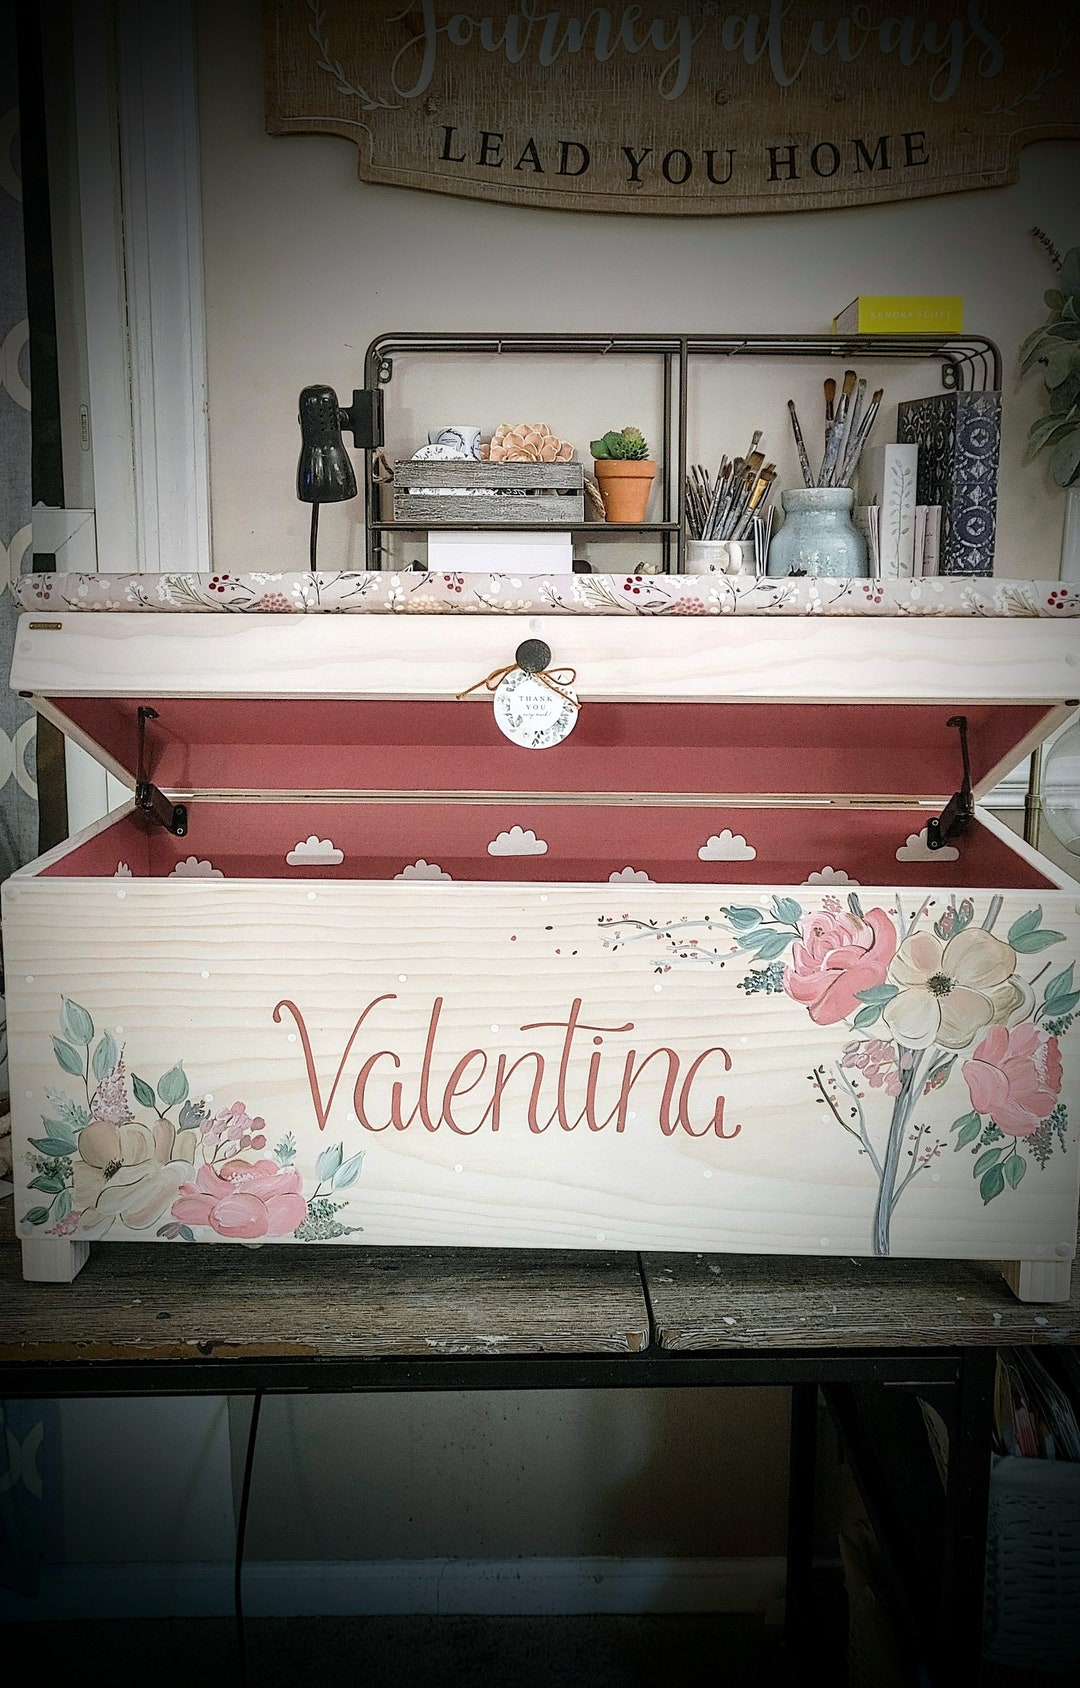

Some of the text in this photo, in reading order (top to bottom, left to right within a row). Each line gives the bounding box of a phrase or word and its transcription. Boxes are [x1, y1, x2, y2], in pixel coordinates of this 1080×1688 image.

[438, 126, 931, 186] LEAD YOU HOME
[870, 310, 952, 319] KENDRA SCOTT
[272, 993, 742, 1139] Valentina
